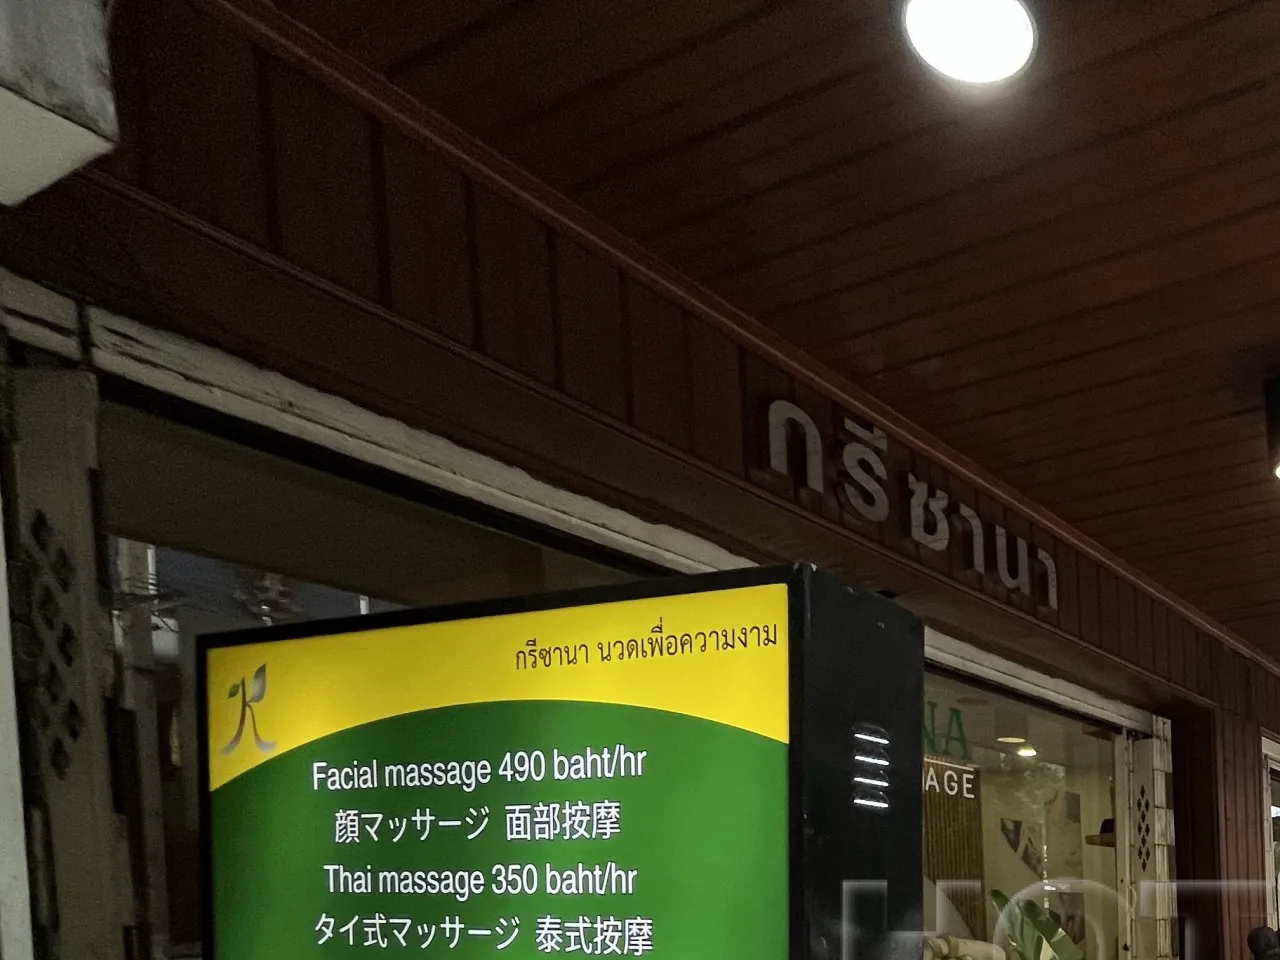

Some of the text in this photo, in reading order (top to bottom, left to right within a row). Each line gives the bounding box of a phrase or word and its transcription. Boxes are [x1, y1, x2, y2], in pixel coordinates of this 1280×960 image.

[597, 617, 778, 663] นวดเพื่อความงาม
[313, 744, 647, 792] Facial massage 490 baht/hr
[923, 766, 975, 799] AGE
[335, 800, 620, 843] 顔マッサージ 面部按摩
[324, 862, 637, 901] Thai massage 350 baht/hr
[315, 913, 653, 955] タイ式マッサージ 泰式按摩
